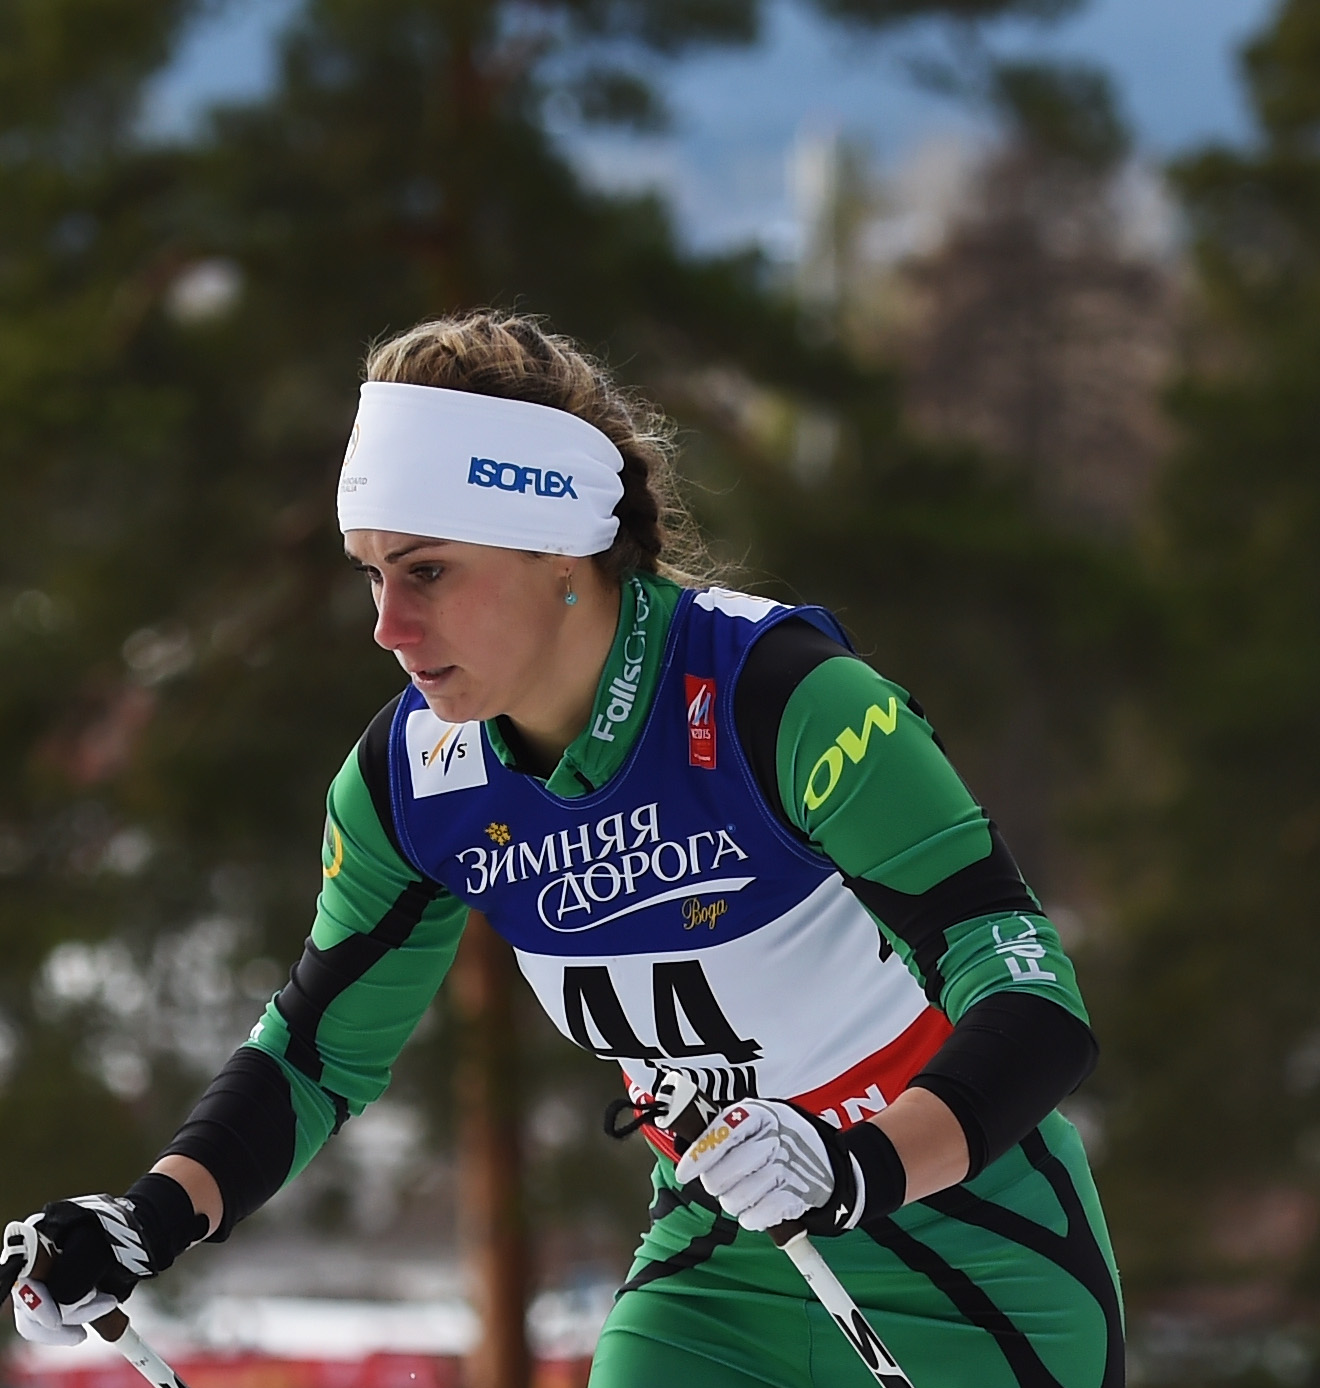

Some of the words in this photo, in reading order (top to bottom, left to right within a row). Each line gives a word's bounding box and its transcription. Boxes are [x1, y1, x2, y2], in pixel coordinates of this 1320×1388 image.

[468, 456, 578, 500] ISOFLEX
[455, 802, 662, 894] ЗИМНЯЯ
[555, 829, 749, 922] ДОРОГА
[562, 959, 765, 1065] 44
